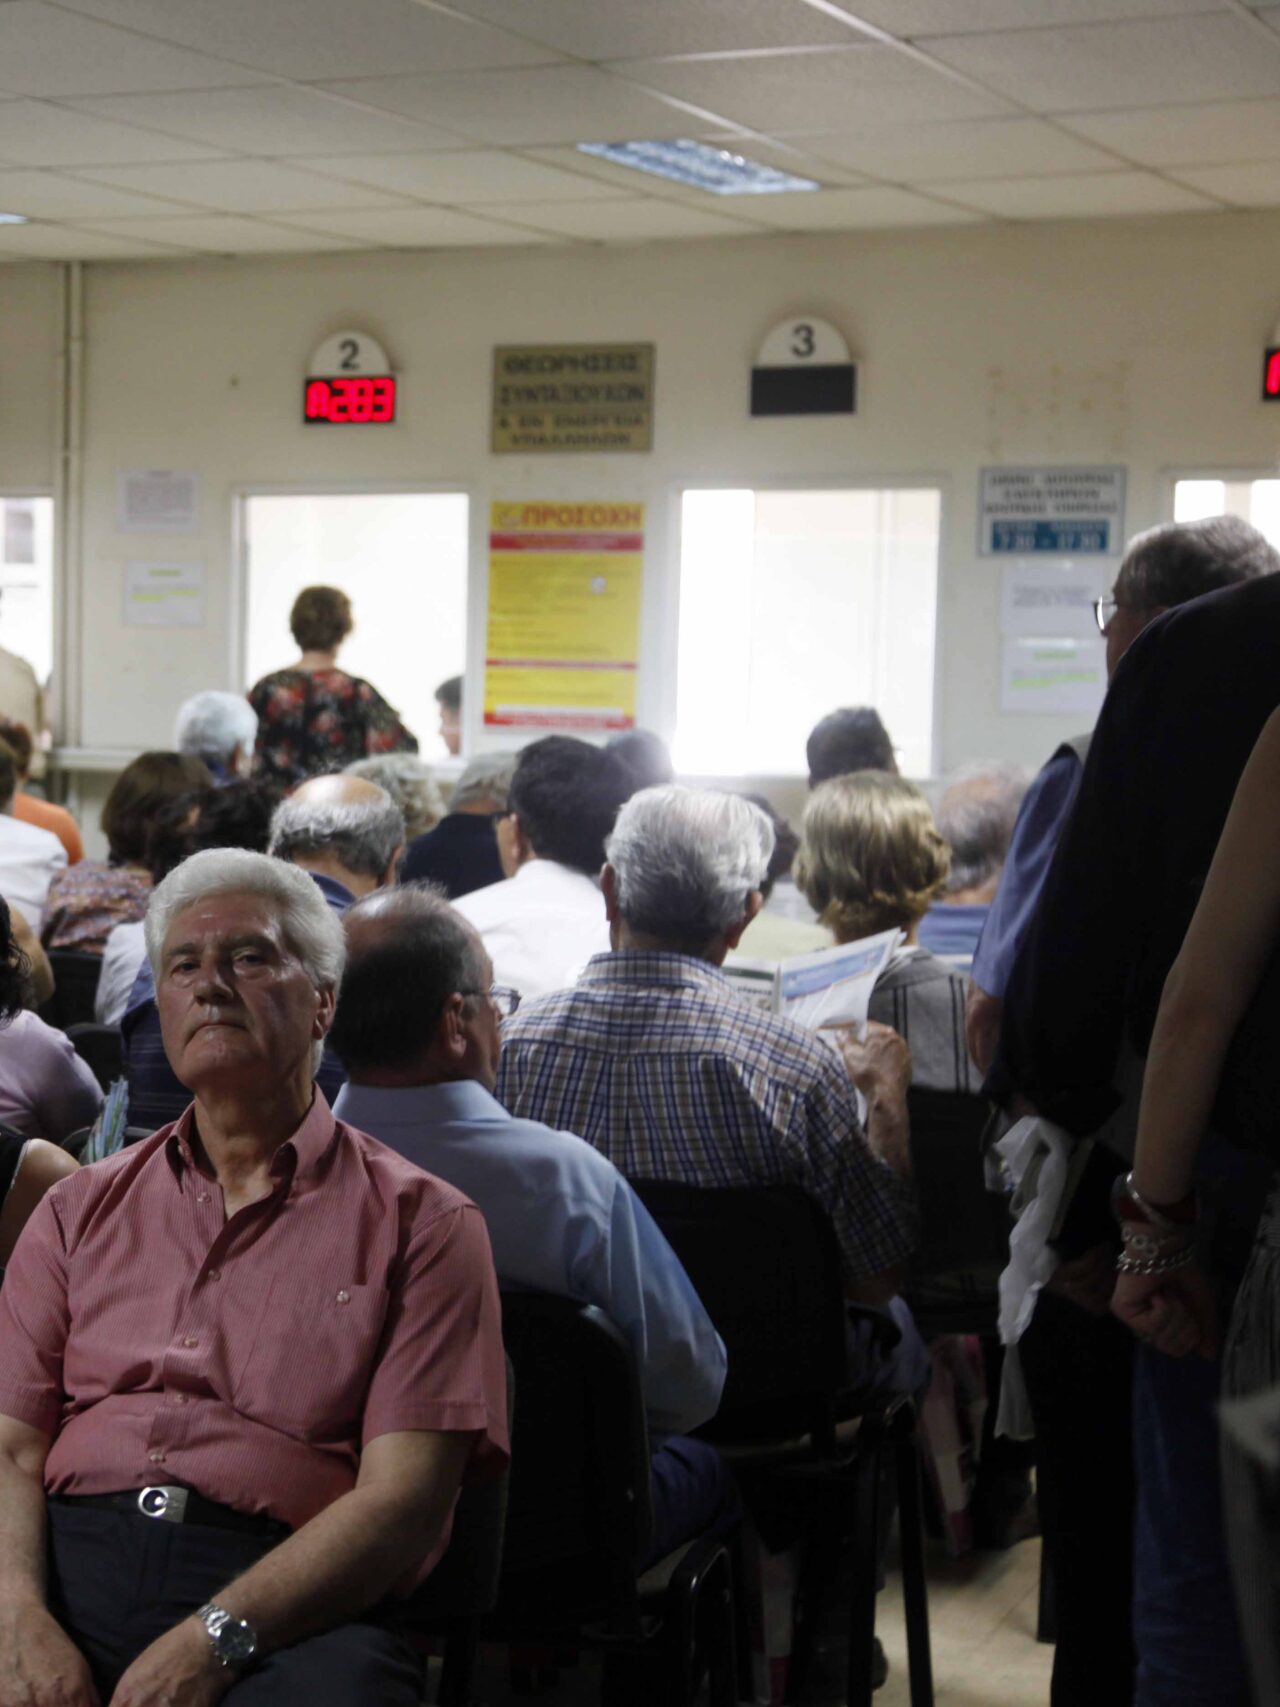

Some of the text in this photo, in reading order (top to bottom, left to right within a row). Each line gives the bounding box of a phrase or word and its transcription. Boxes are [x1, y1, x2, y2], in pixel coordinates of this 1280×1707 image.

[338, 338, 360, 370] 2
[792, 324, 817, 358] 3
[522, 504, 641, 527] ΠΡΟΣΟΧΗ
